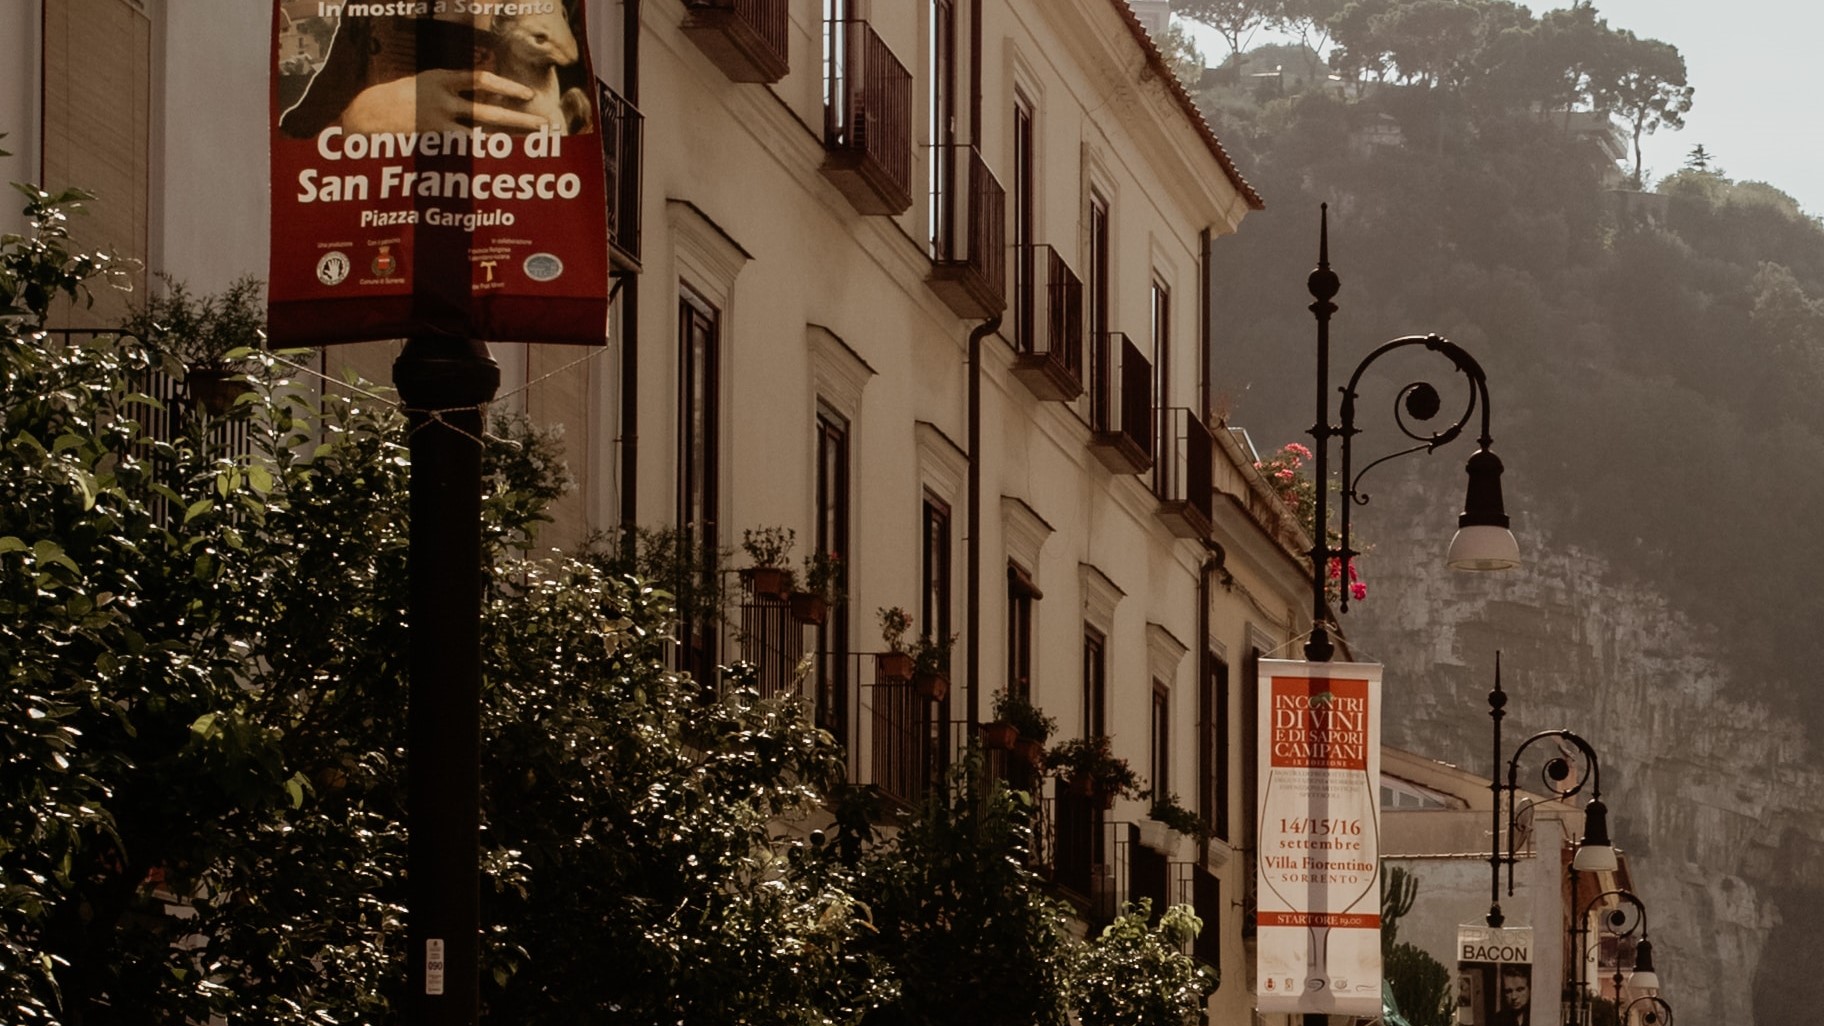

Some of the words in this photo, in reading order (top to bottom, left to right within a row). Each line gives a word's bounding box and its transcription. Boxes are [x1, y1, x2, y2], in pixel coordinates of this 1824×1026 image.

[317, 1, 341, 17] In
[348, 0, 428, 16] mostra
[432, 2, 447, 13] a
[454, 0, 554, 16] Sorrento
[317, 125, 513, 160] Convento
[523, 123, 562, 158] di
[297, 168, 369, 203] San
[379, 166, 581, 200] Francesco
[360, 209, 420, 228] Piazza
[424, 208, 516, 232] Gargiulo
[1275, 694, 1364, 711] INCONTRI
[1276, 709, 1303, 729] DI
[1310, 711, 1364, 731] VINI
[1275, 730, 1286, 741] E
[1289, 730, 1306, 742] DI
[1309, 730, 1364, 744] SAPORI
[1275, 742, 1364, 760] CAMPANI
[1305, 759, 1346, 767] EDIZIONE
[1279, 817, 1361, 836] 14/15/16
[1279, 837, 1361, 851] settembre
[1265, 856, 1298, 869] Villa
[1302, 857, 1374, 872] Fiorentino
[1281, 873, 1358, 884] SORRENTO
[1277, 915, 1311, 925] START
[1315, 915, 1338, 925] ORE
[1339, 917, 1362, 926] 19.00
[1462, 945, 1528, 962] BACON
